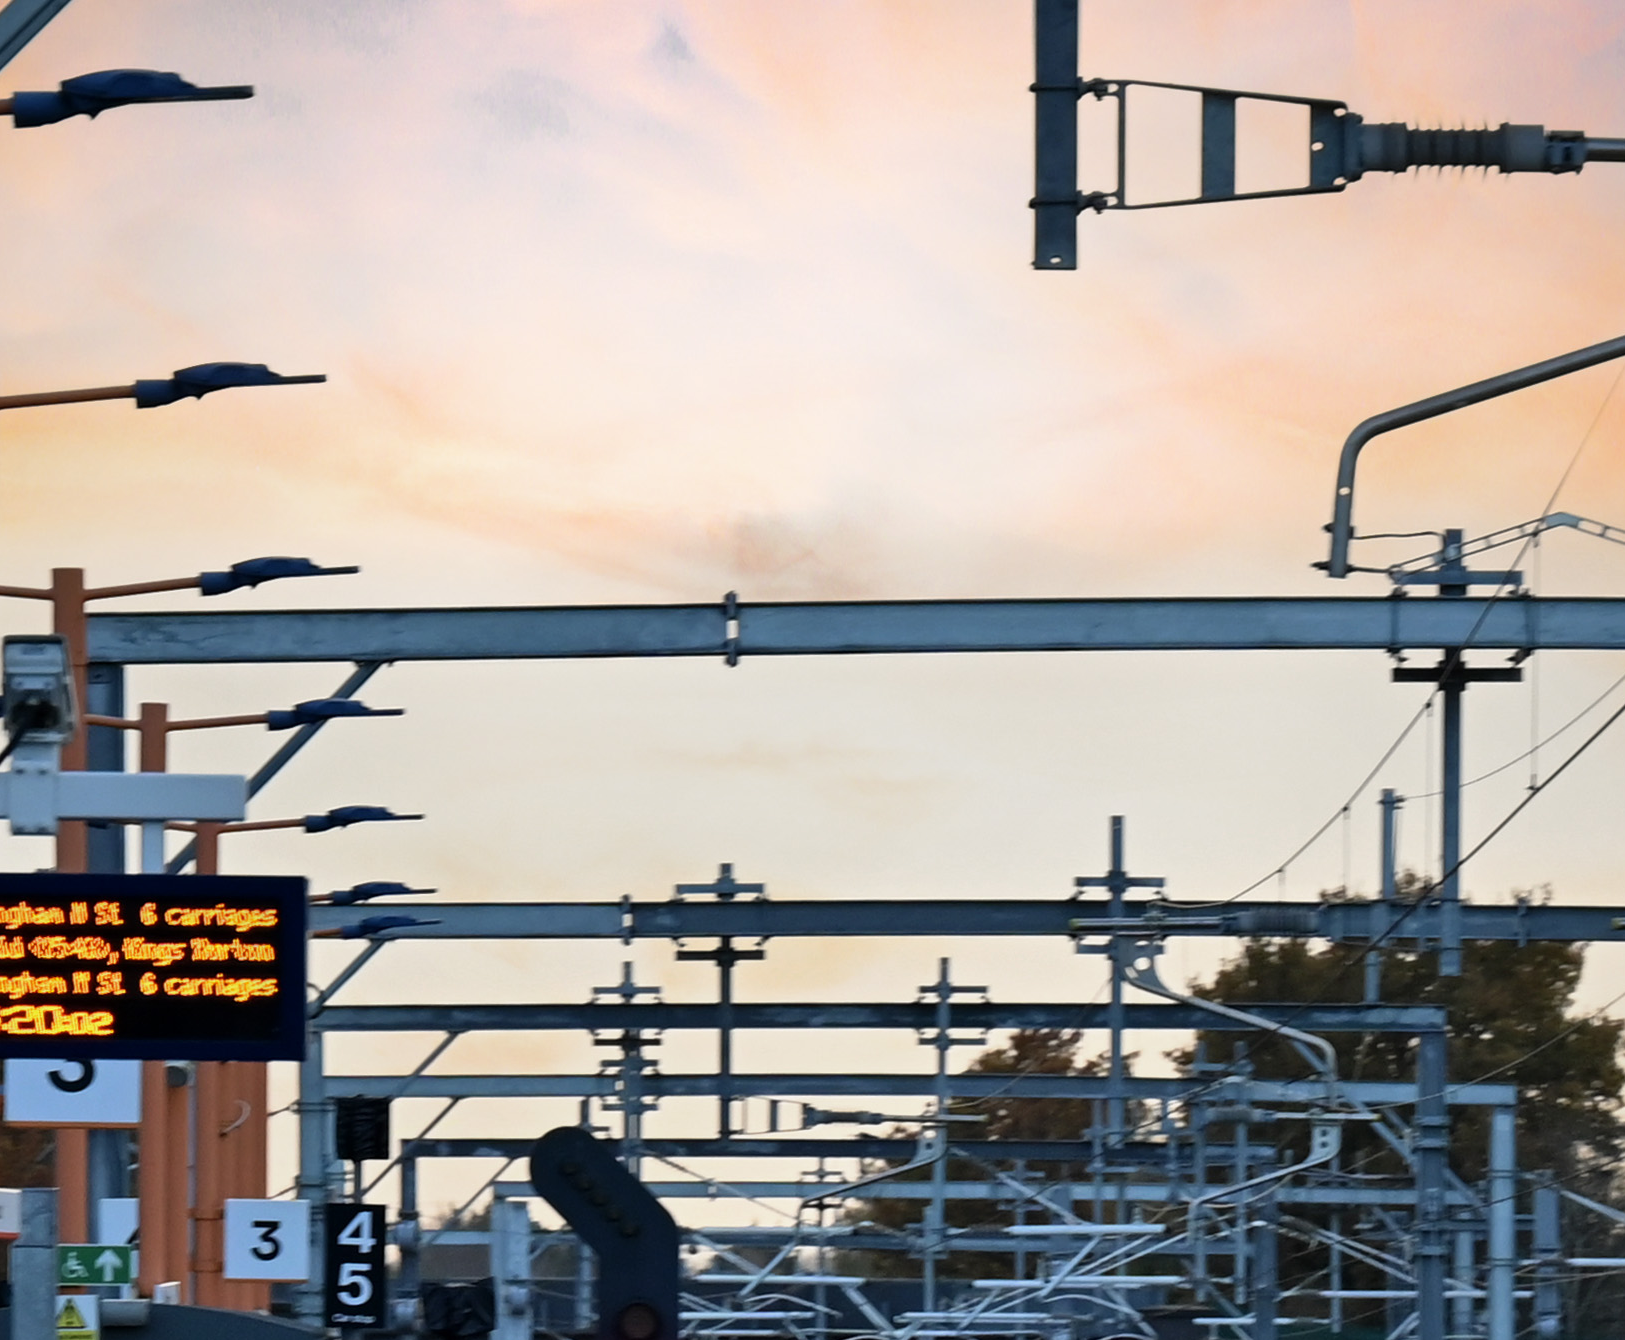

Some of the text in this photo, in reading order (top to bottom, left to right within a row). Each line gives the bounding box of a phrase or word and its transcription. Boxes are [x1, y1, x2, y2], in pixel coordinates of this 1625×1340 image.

[140, 903, 158, 925] 6
[165, 903, 278, 932] carriages
[140, 972, 158, 995] 6
[163, 973, 278, 1002] carriages
[250, 1220, 282, 1262] 3
[337, 1211, 378, 1254] 4
[336, 1262, 373, 1306] 5
